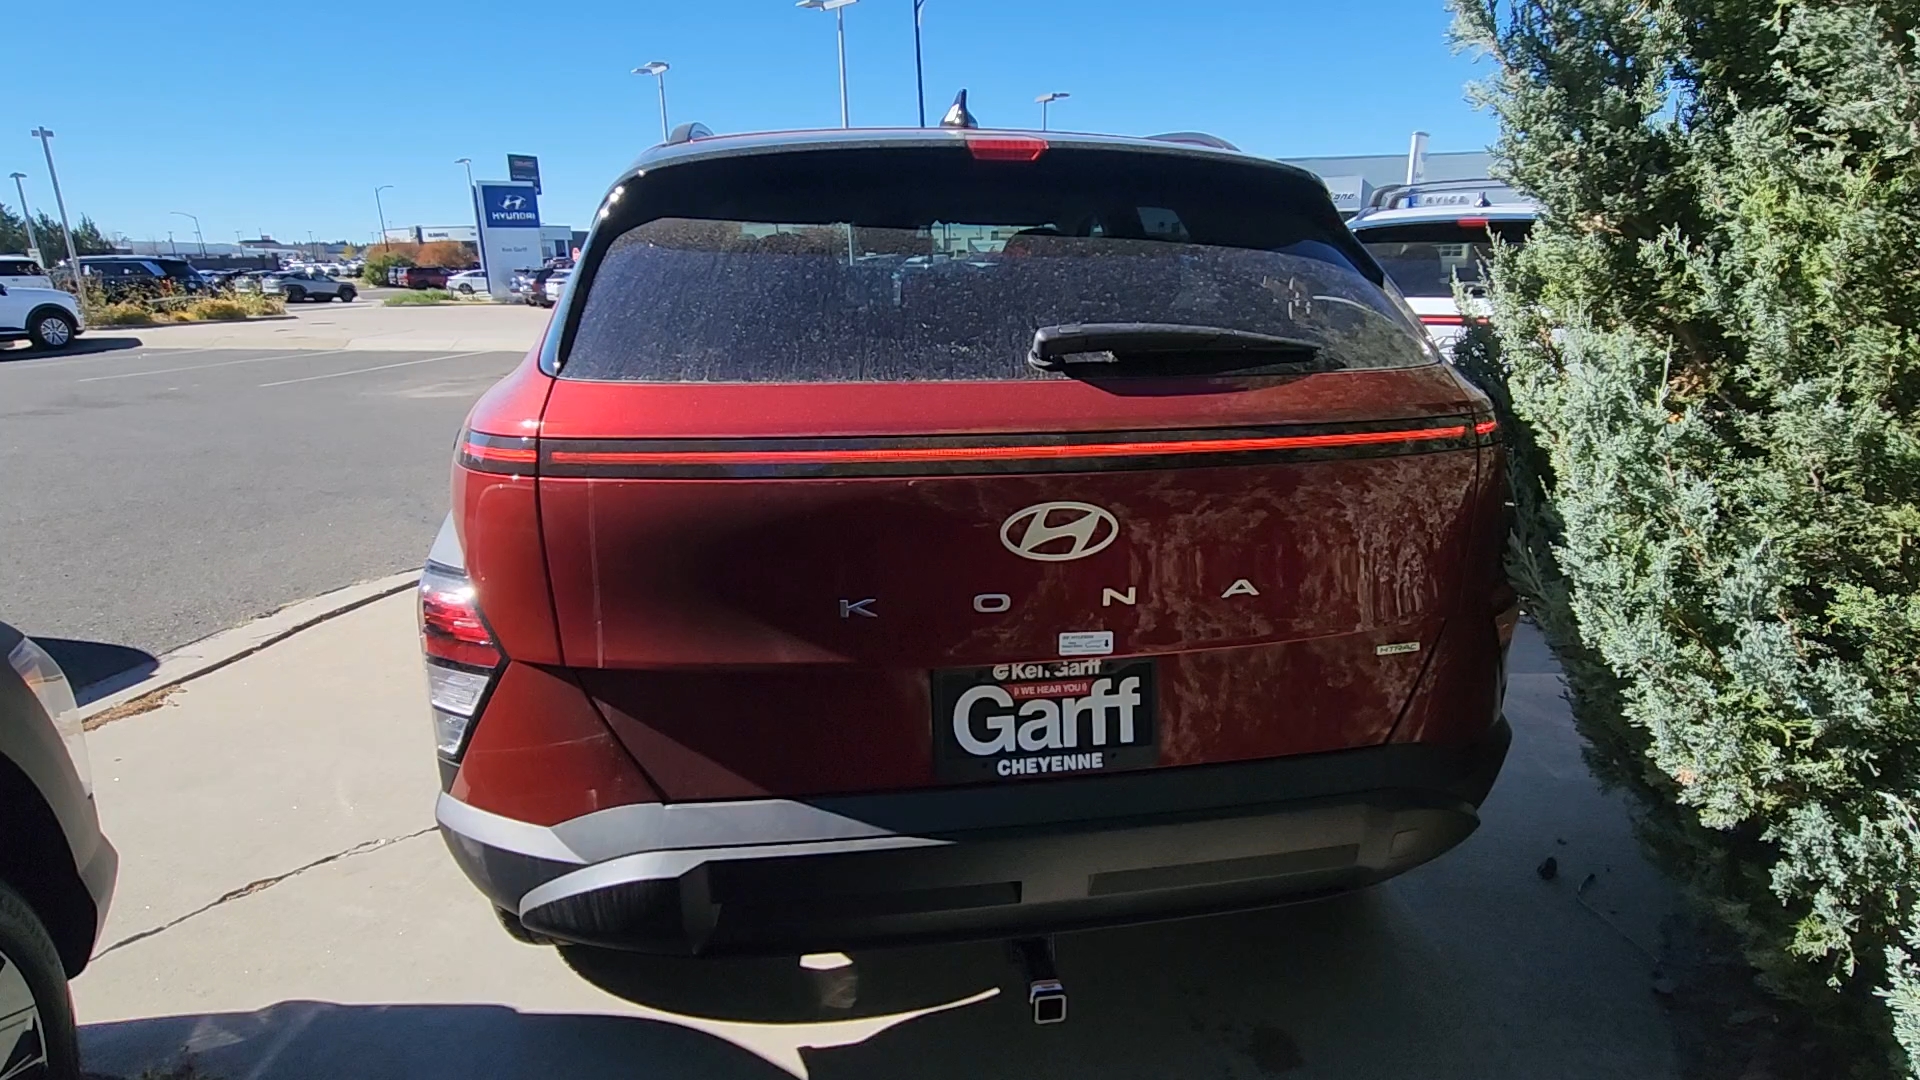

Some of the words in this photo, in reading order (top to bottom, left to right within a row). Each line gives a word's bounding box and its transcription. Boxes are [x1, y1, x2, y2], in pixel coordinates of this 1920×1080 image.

[491, 211, 536, 220] HYUNDAI
[1379, 643, 1417, 653] HTRAC
[1021, 685, 1036, 695] WE
[1036, 684, 1062, 694] HEAR
[1063, 683, 1081, 693] YOU
[952, 676, 1141, 756] Garff
[997, 752, 1104, 777] CHEYENNE
